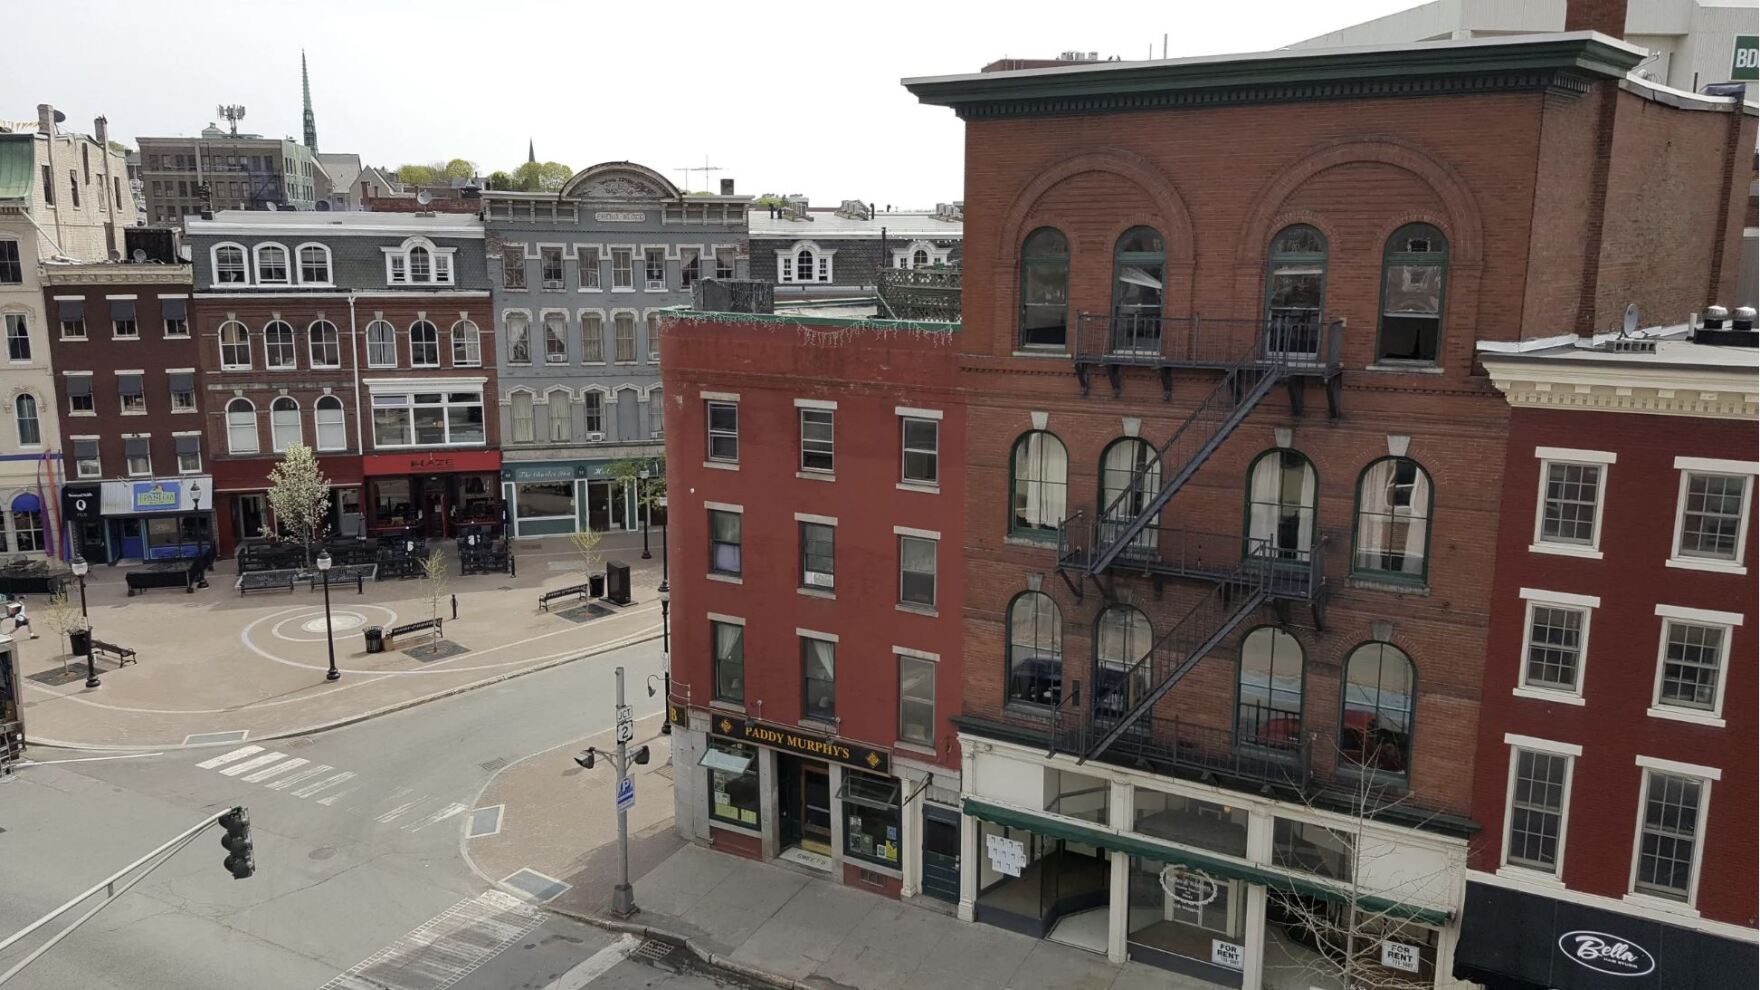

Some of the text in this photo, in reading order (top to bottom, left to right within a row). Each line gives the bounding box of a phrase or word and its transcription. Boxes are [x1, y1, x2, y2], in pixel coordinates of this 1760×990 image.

[1736, 48, 1759, 68] BD
[618, 708, 631, 720] JCT
[621, 726, 629, 739] 2
[745, 725, 850, 760] PADDY MURPHY'S
[1220, 943, 1237, 953] FOR
[1391, 944, 1410, 953] FOR
[1575, 935, 1639, 962] Bella
[1217, 949, 1240, 960] RENT
[1387, 950, 1413, 962] RENT
